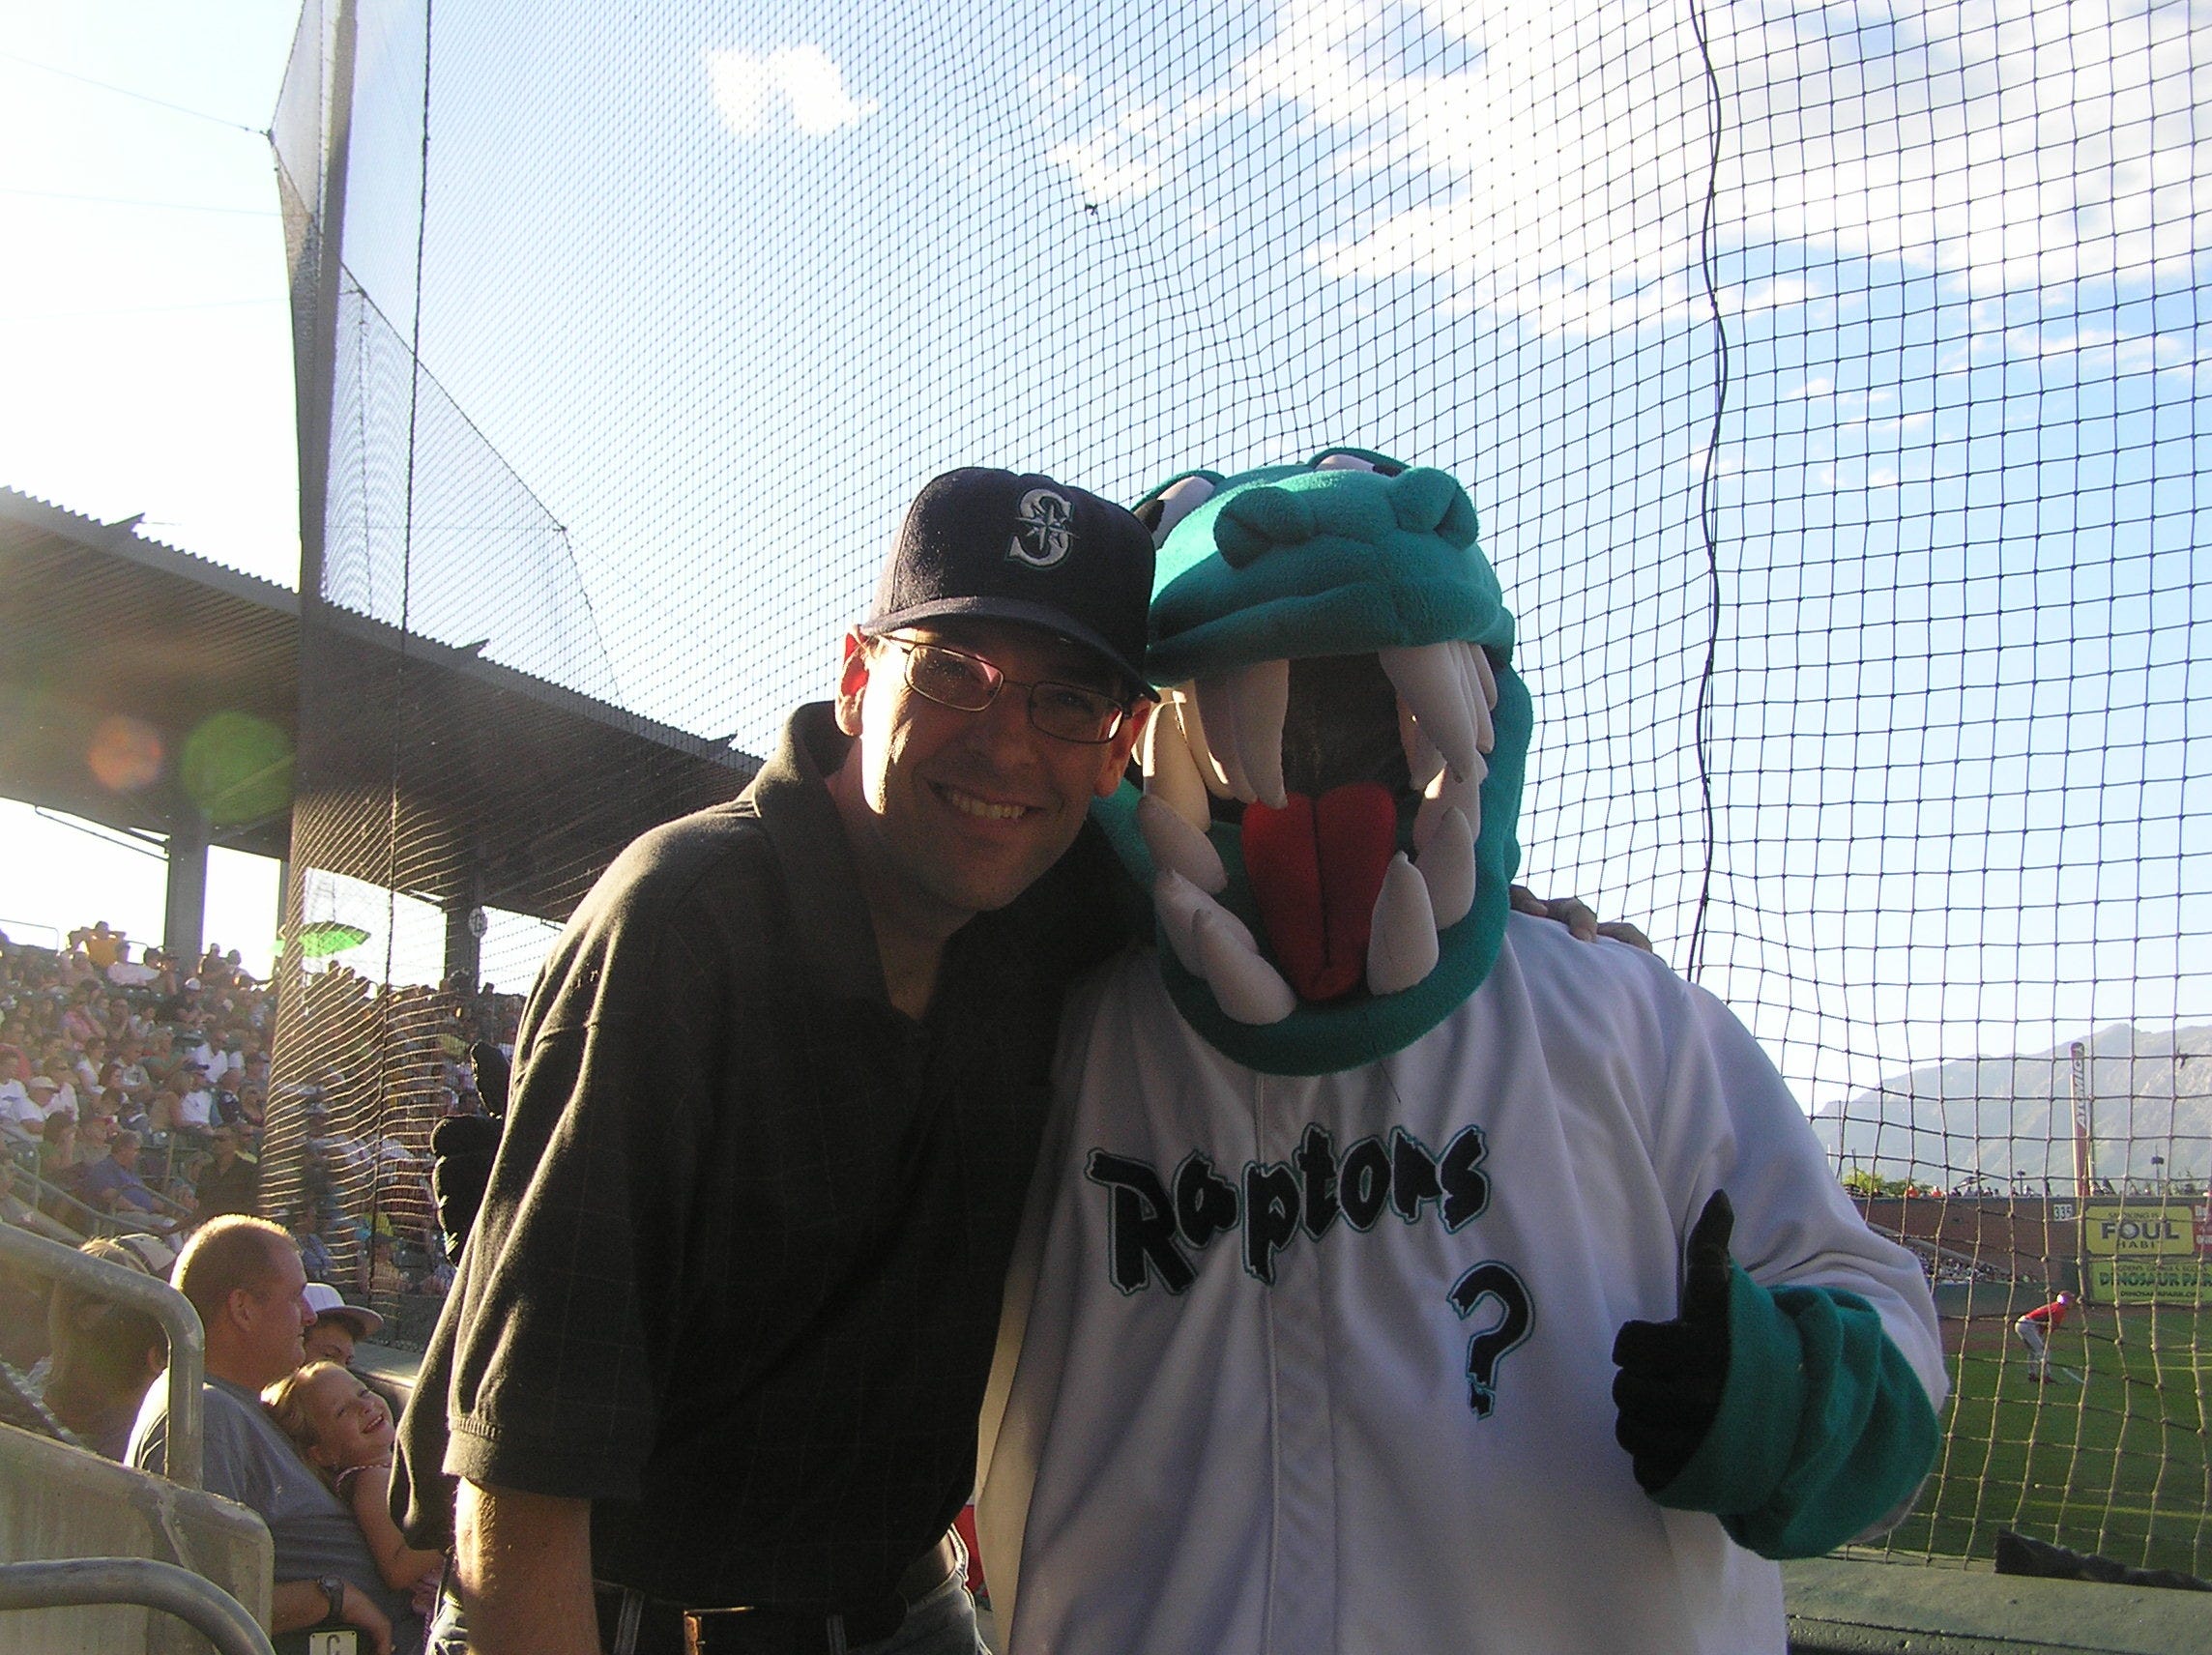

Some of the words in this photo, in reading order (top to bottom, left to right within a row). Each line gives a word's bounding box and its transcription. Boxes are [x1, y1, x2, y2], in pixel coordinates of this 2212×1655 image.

[1084, 1121, 1491, 1295] Raptors
[2054, 1205, 2072, 1220] 335
[2101, 1221, 2180, 1240] FOUL
